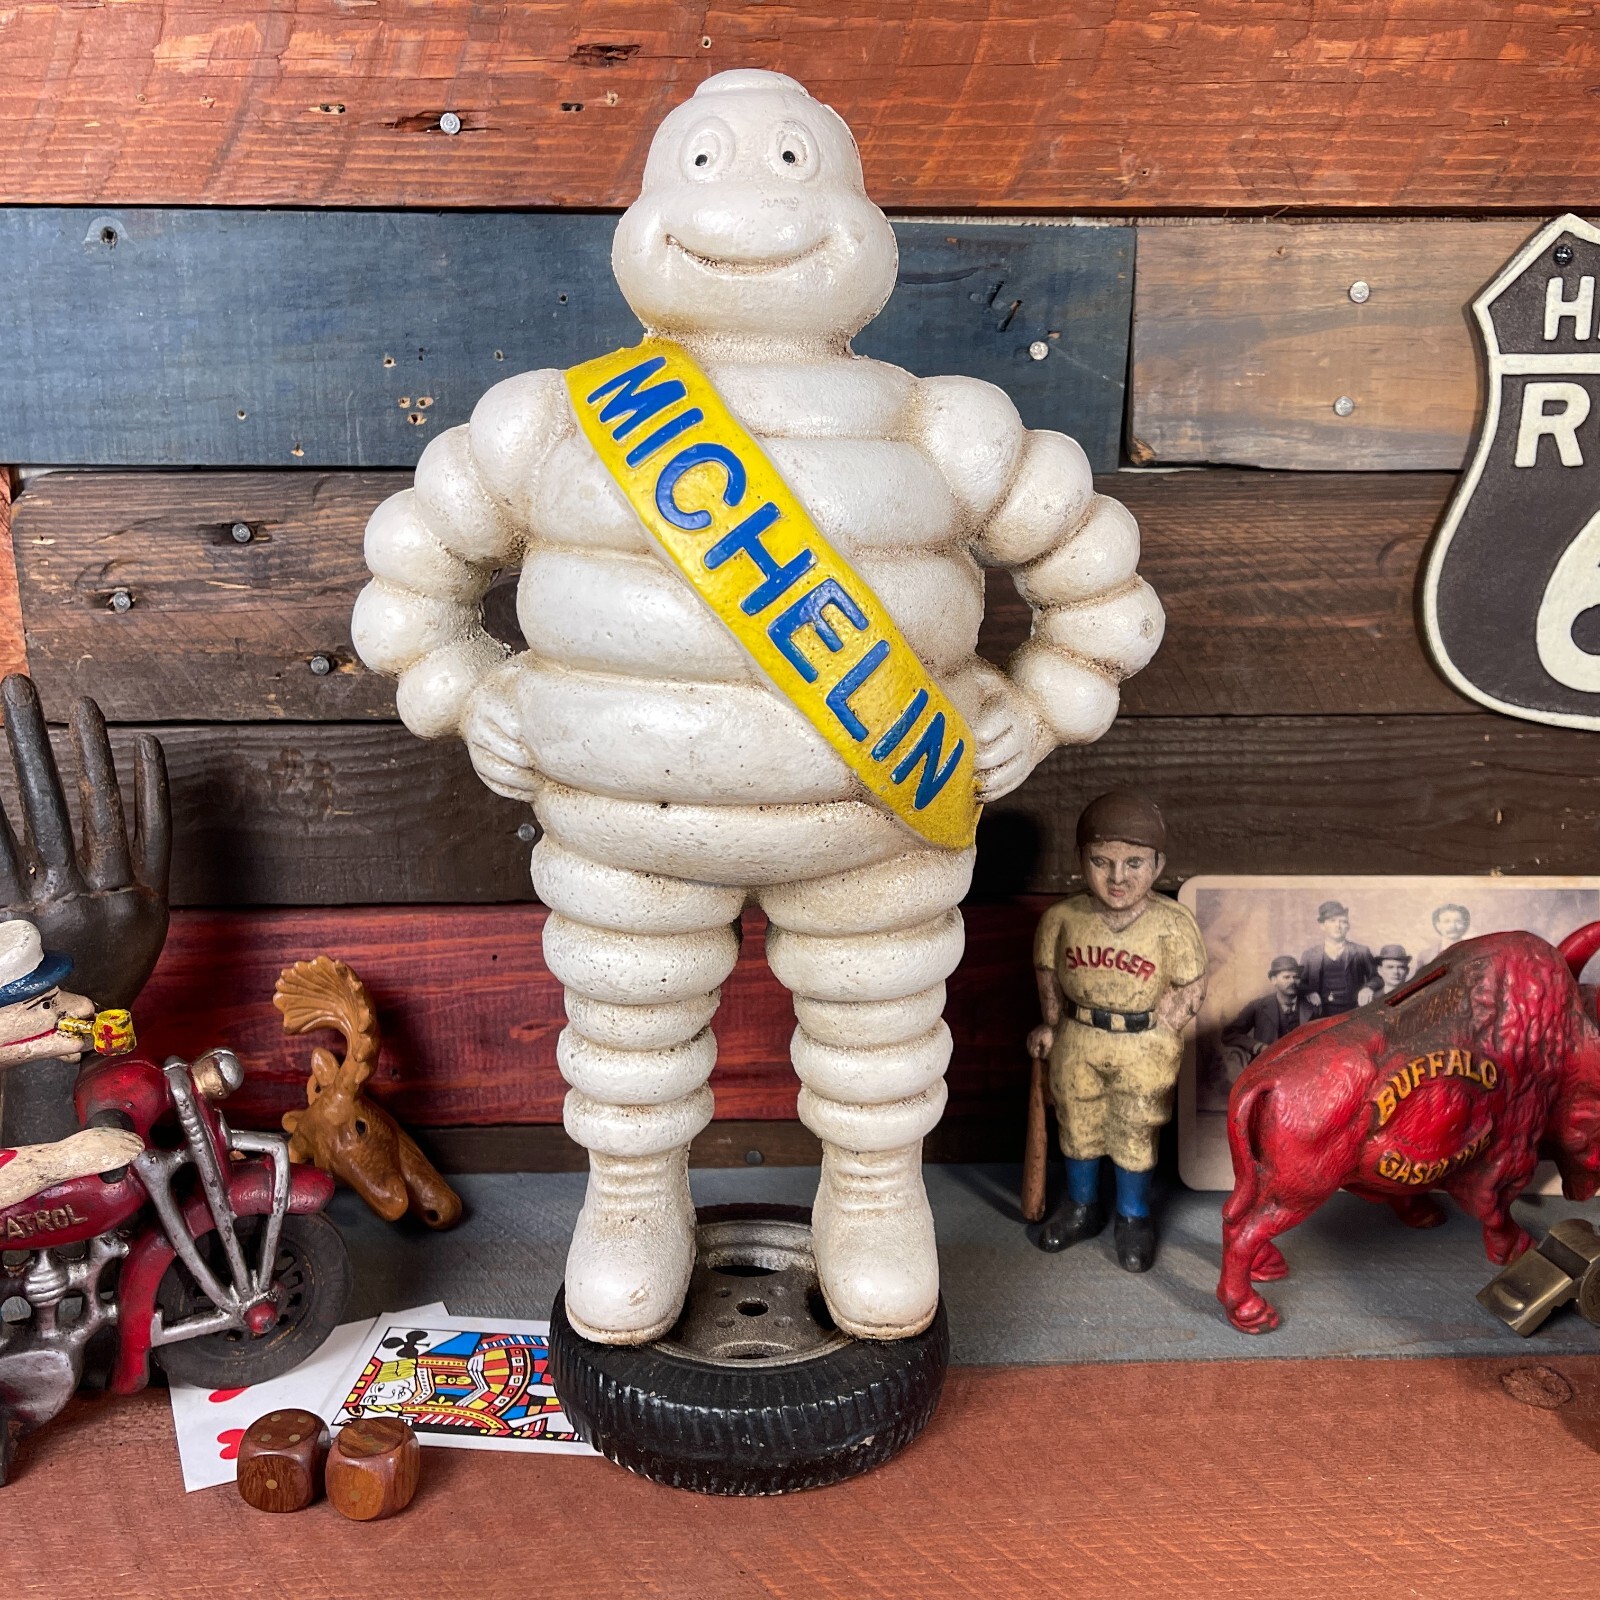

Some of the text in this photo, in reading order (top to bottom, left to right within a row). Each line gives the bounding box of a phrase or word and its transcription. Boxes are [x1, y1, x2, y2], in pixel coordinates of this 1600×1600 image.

[1543, 275, 1600, 341] H
[588, 356, 965, 810] MICHELIN
[1065, 945, 1156, 982] SLUGGER
[1377, 1049, 1497, 1126] BUFFALO
[0, 1204, 88, 1239] ATROL
